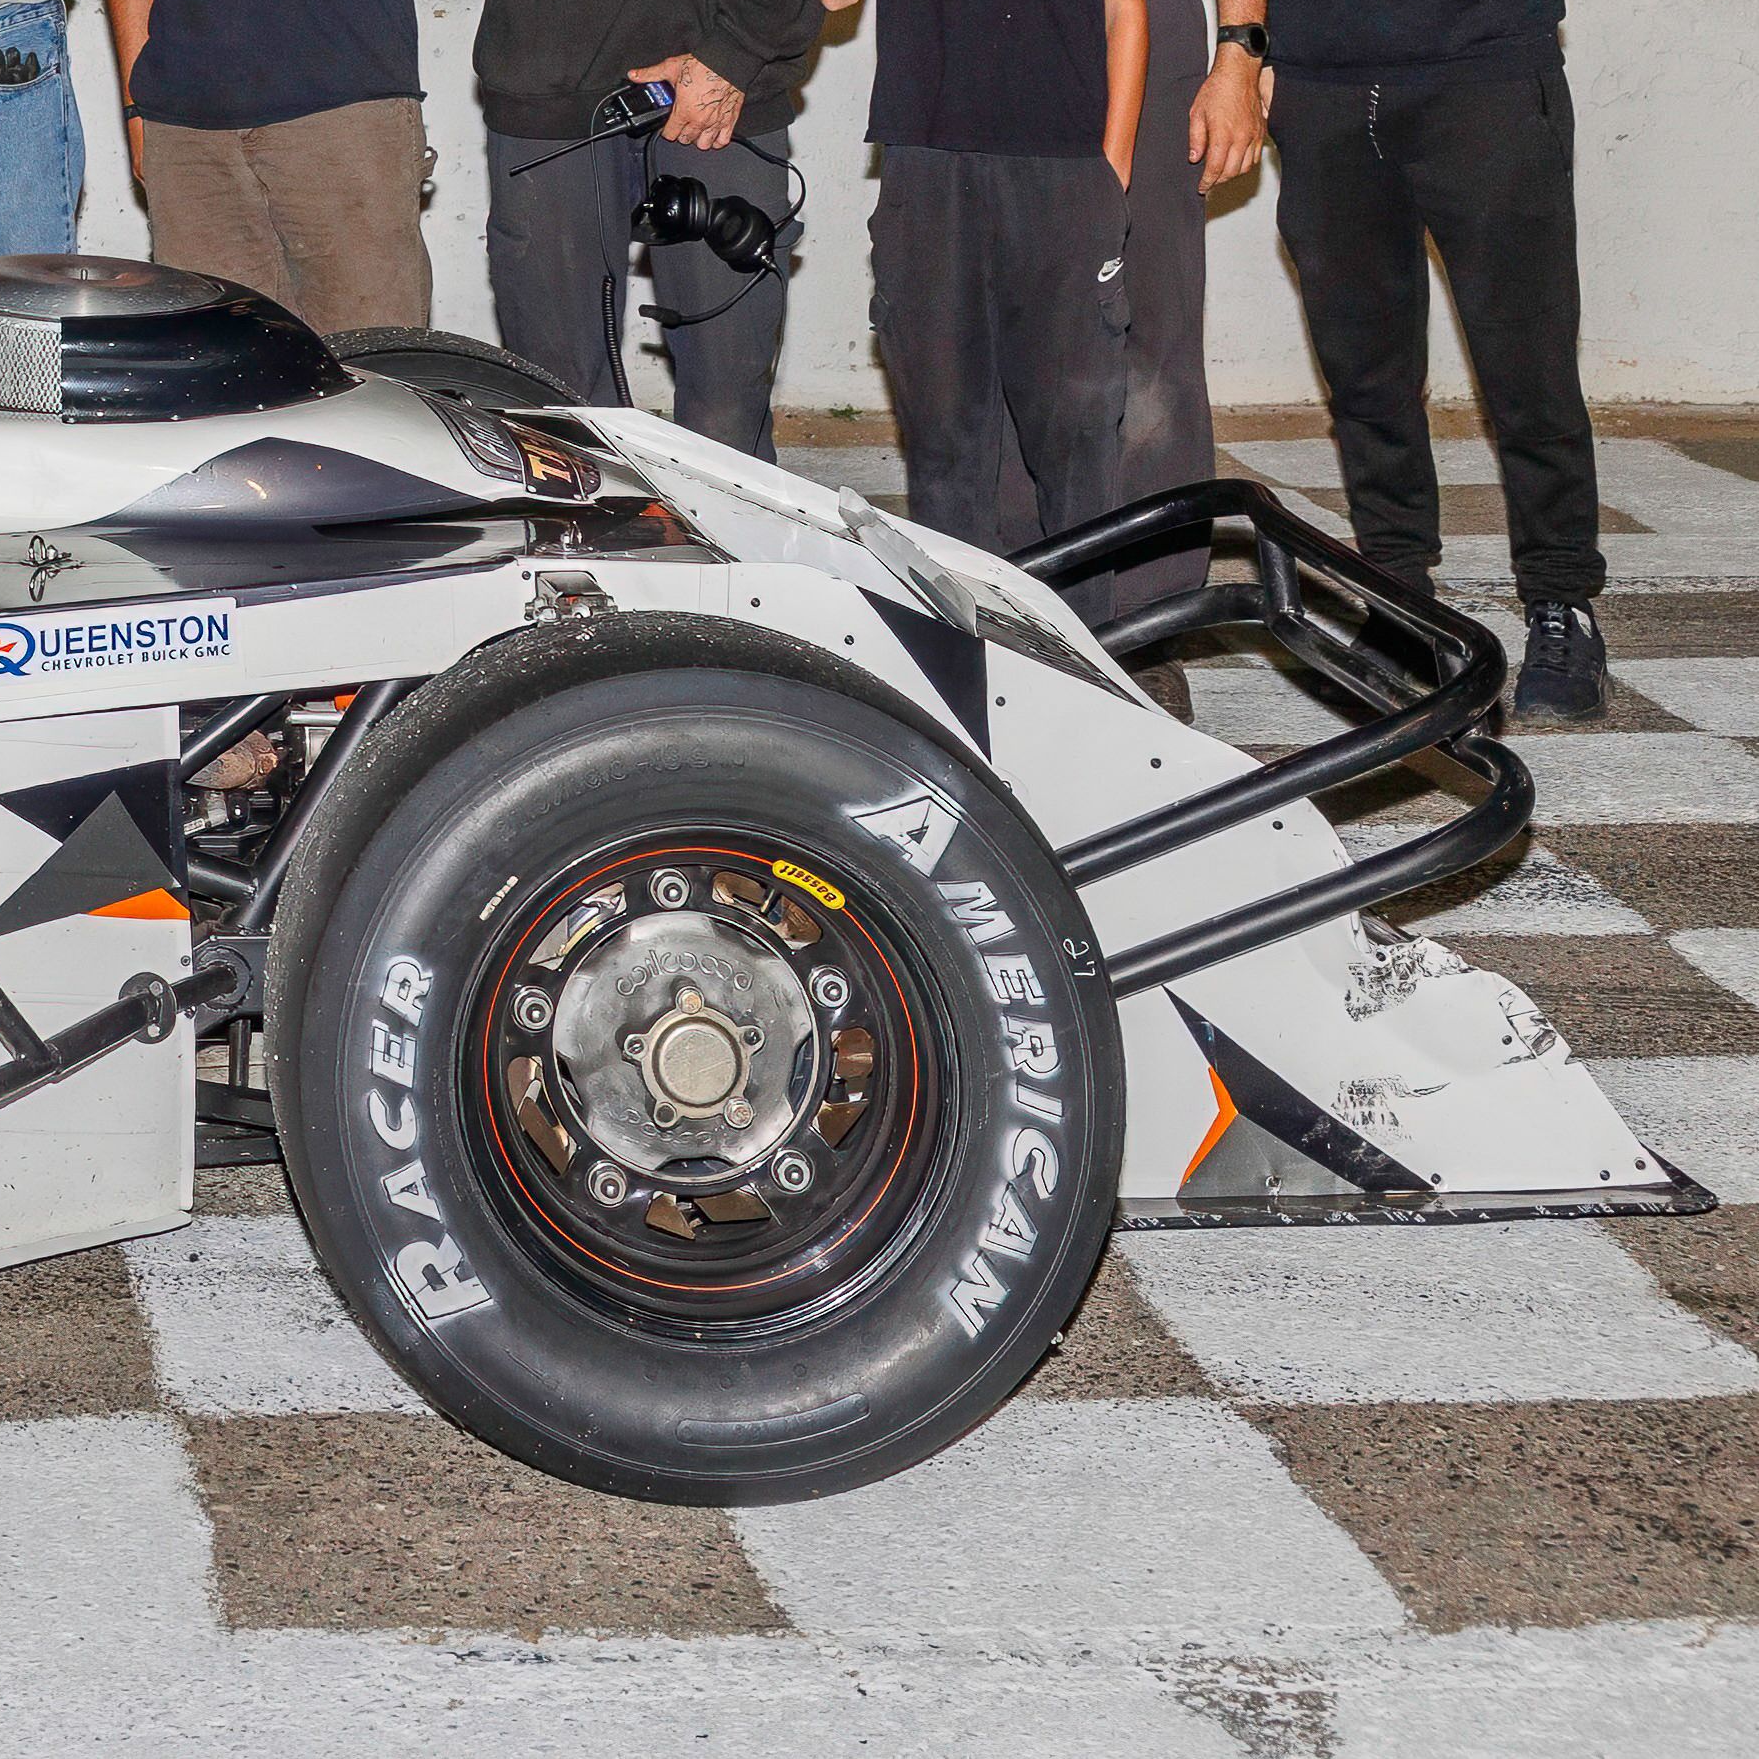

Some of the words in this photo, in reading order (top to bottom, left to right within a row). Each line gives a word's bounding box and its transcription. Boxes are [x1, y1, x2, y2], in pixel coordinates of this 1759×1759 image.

[42, 653, 134, 672] CHEVROLET
[142, 648, 189, 664] BUICK
[195, 642, 232, 658] GMC
[778, 863, 838, 904] Bassett
[368, 954, 494, 1322] RACER
[847, 791, 1061, 1337] AMERICAN
